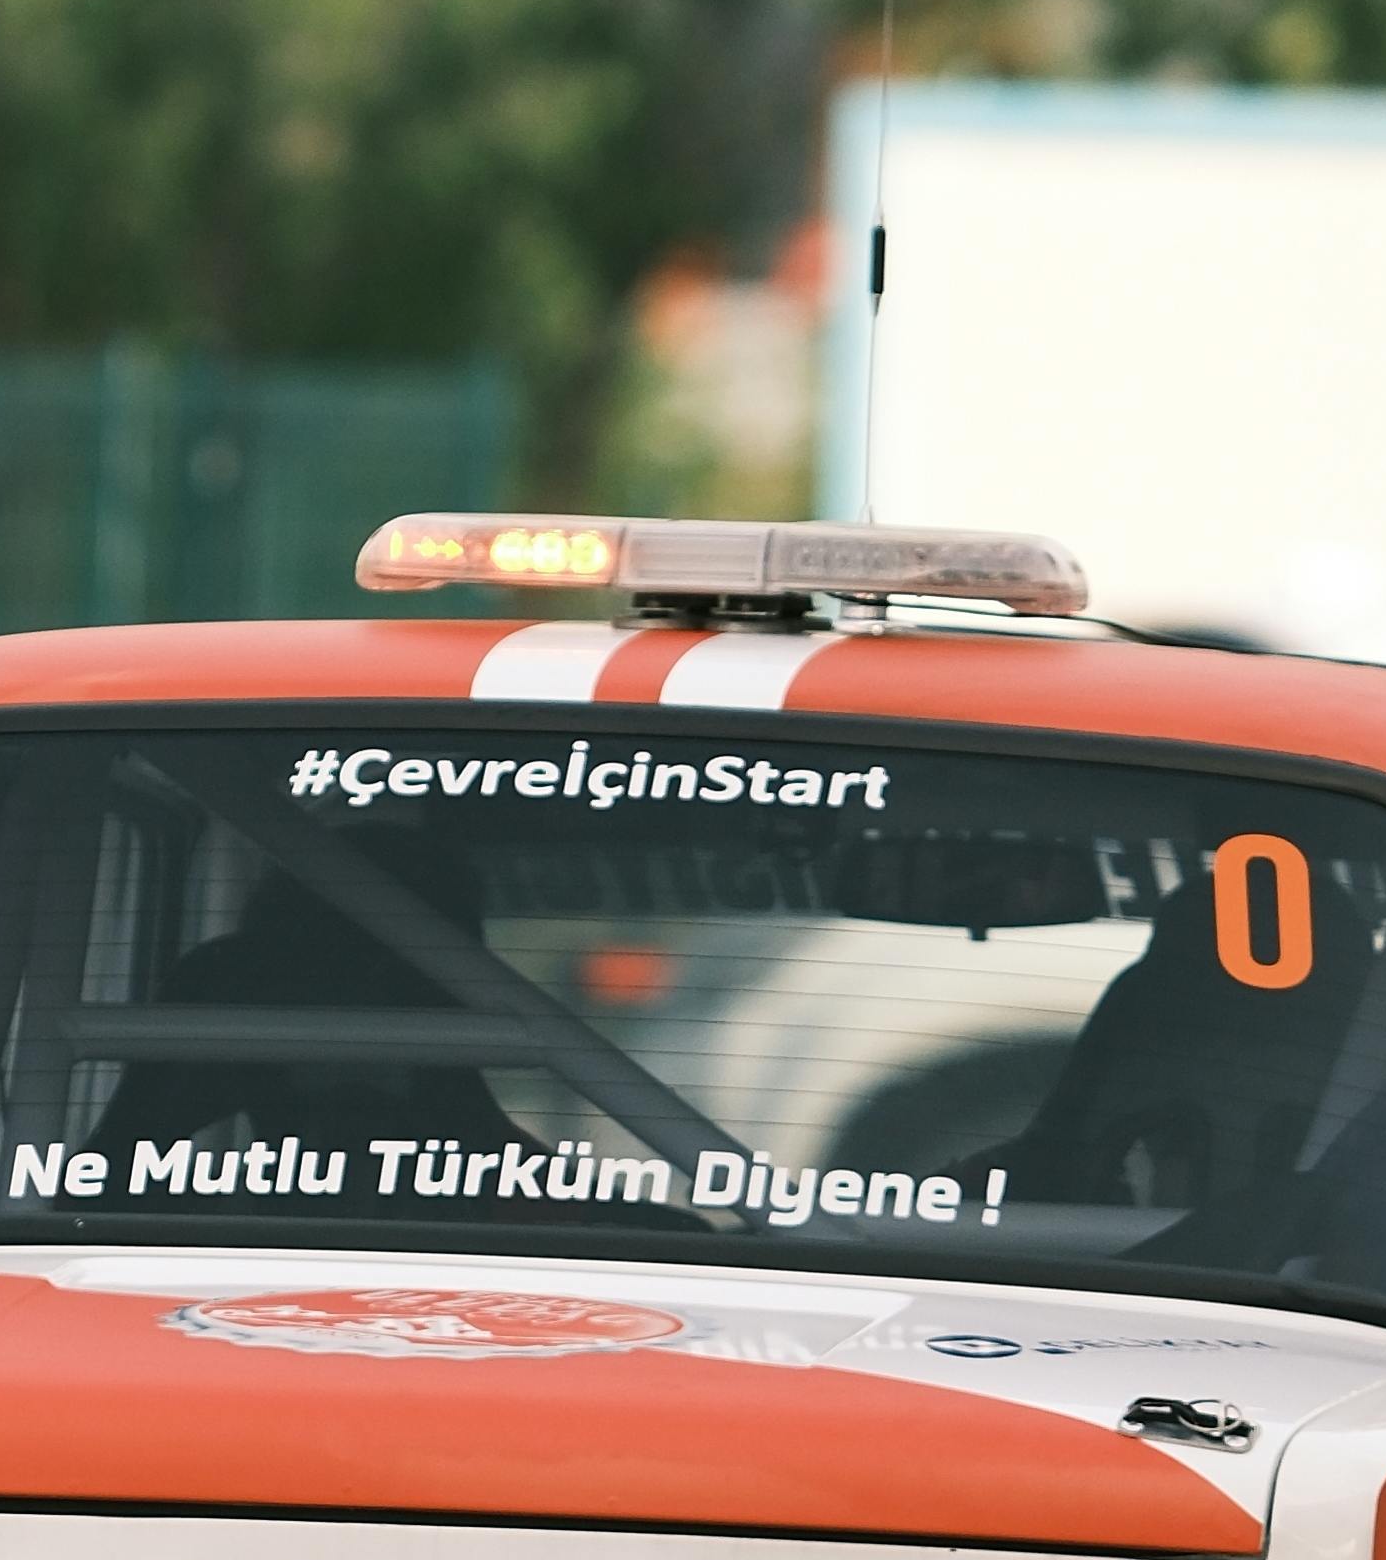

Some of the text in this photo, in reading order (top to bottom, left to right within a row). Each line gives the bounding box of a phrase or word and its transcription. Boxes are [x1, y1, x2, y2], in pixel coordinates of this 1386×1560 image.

[288, 740, 891, 810] #ÇevreİçinStart
[1212, 833, 1313, 990] 0
[8, 1137, 1008, 1227] Ne Mutlu Türküm Diyene !
